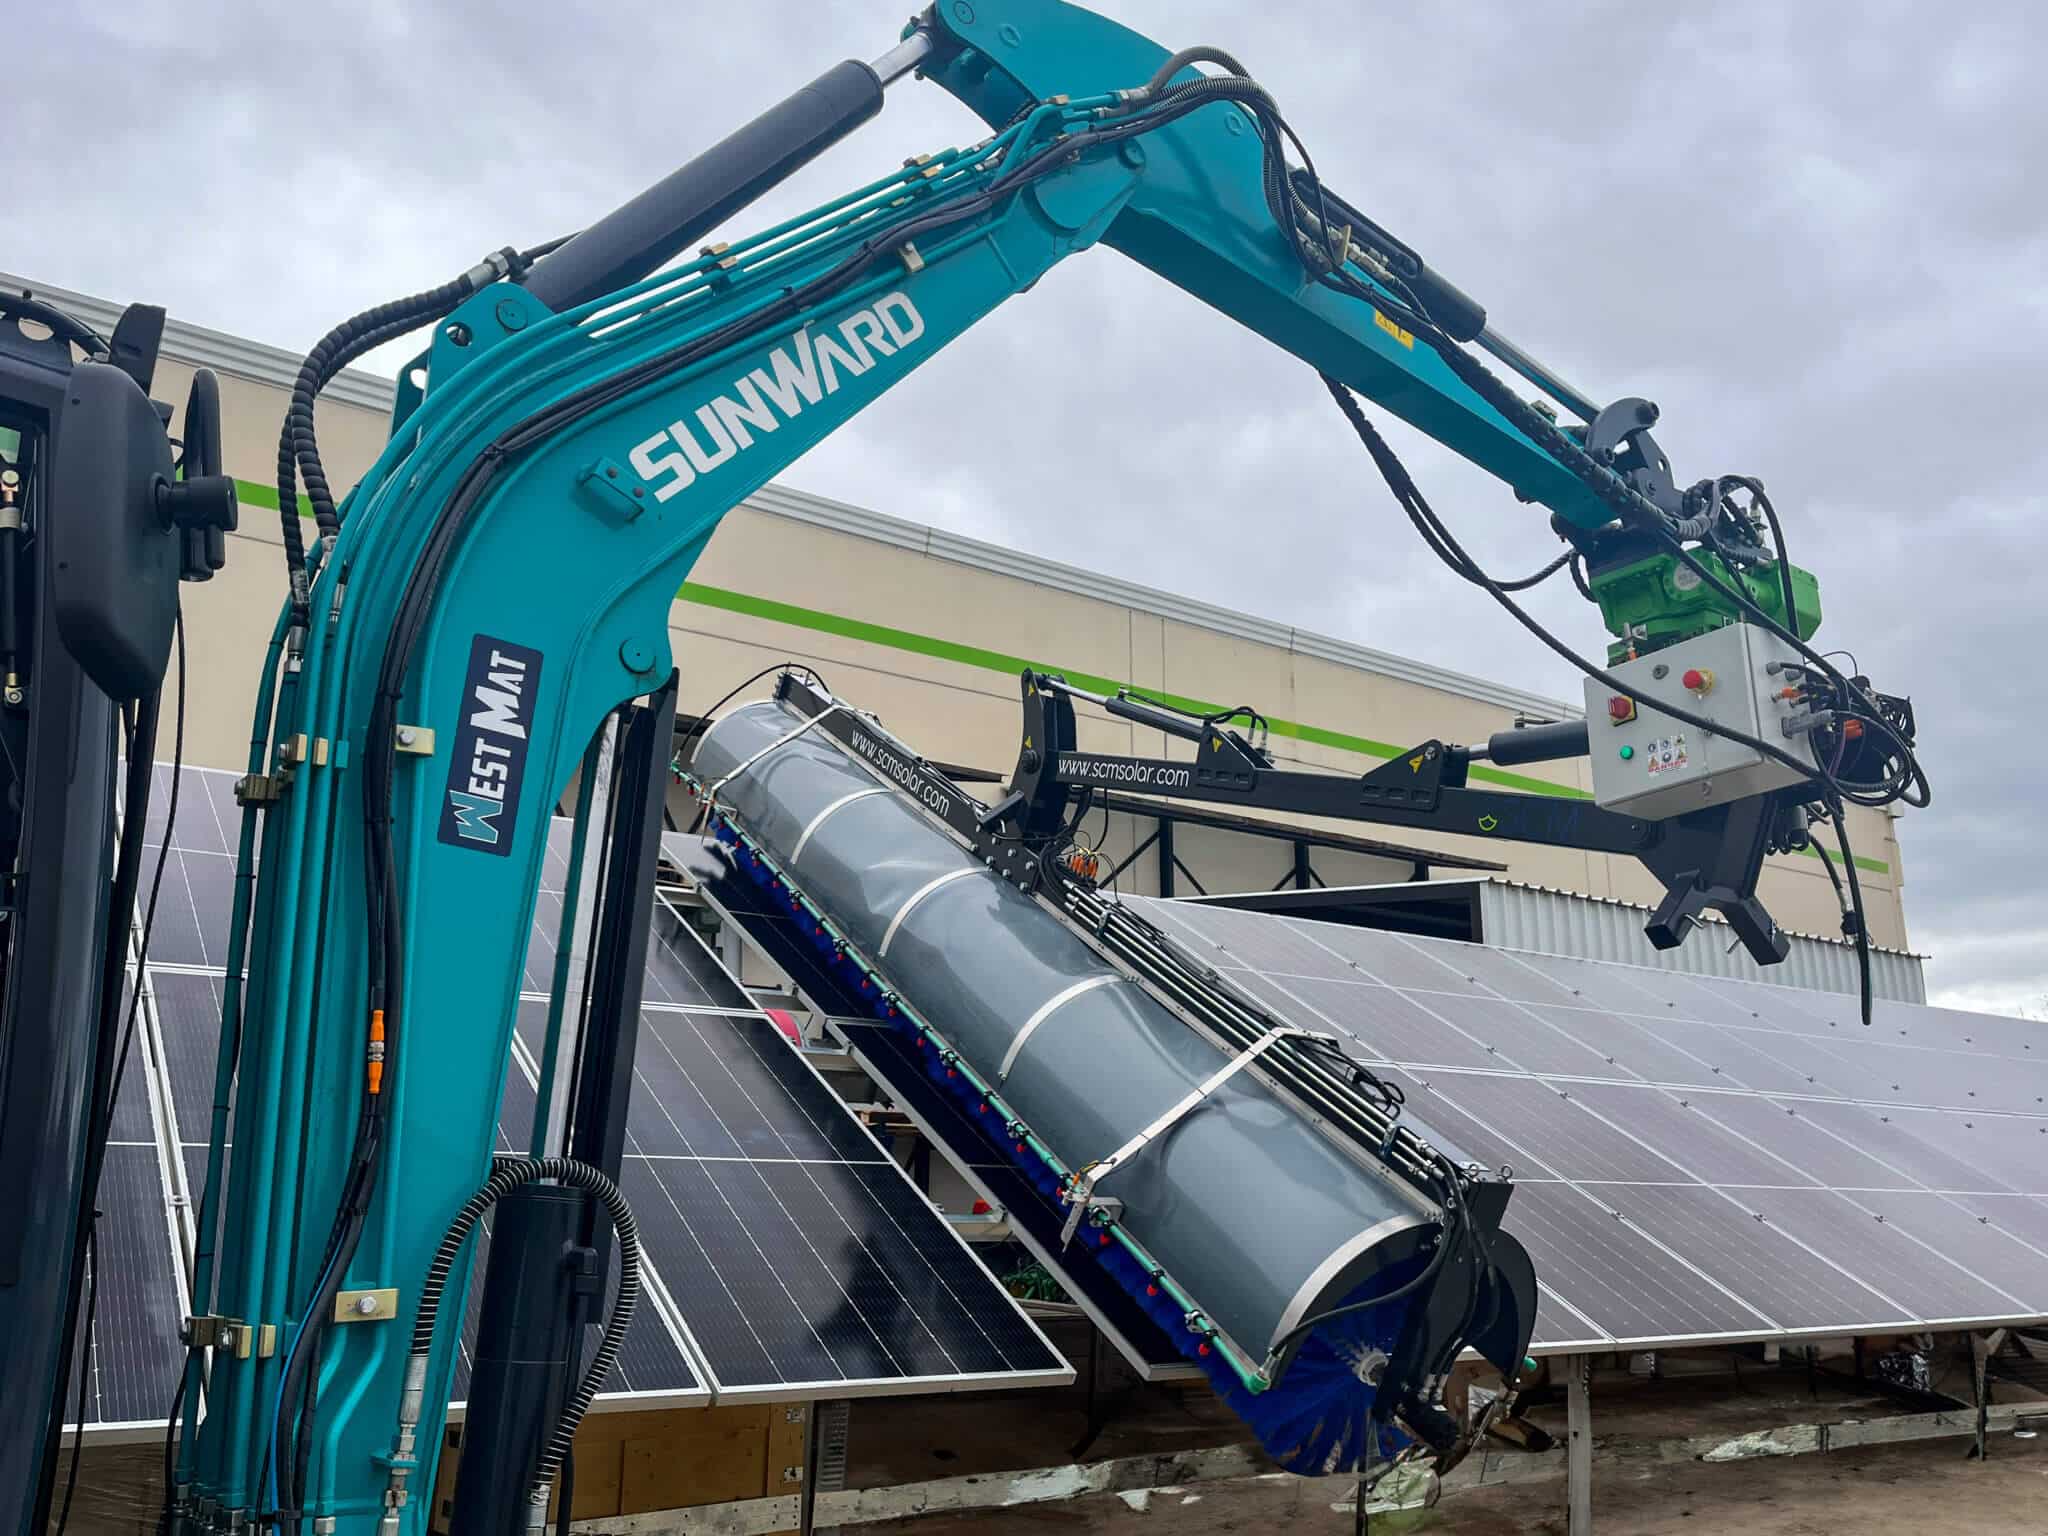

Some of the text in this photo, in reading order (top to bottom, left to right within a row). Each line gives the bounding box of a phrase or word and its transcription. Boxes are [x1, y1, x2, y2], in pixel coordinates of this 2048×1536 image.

[629, 291, 925, 503] SUNWARD
[851, 730, 950, 817] www.scmsolar.com
[1058, 759, 1190, 787] www.scmsolar.com
